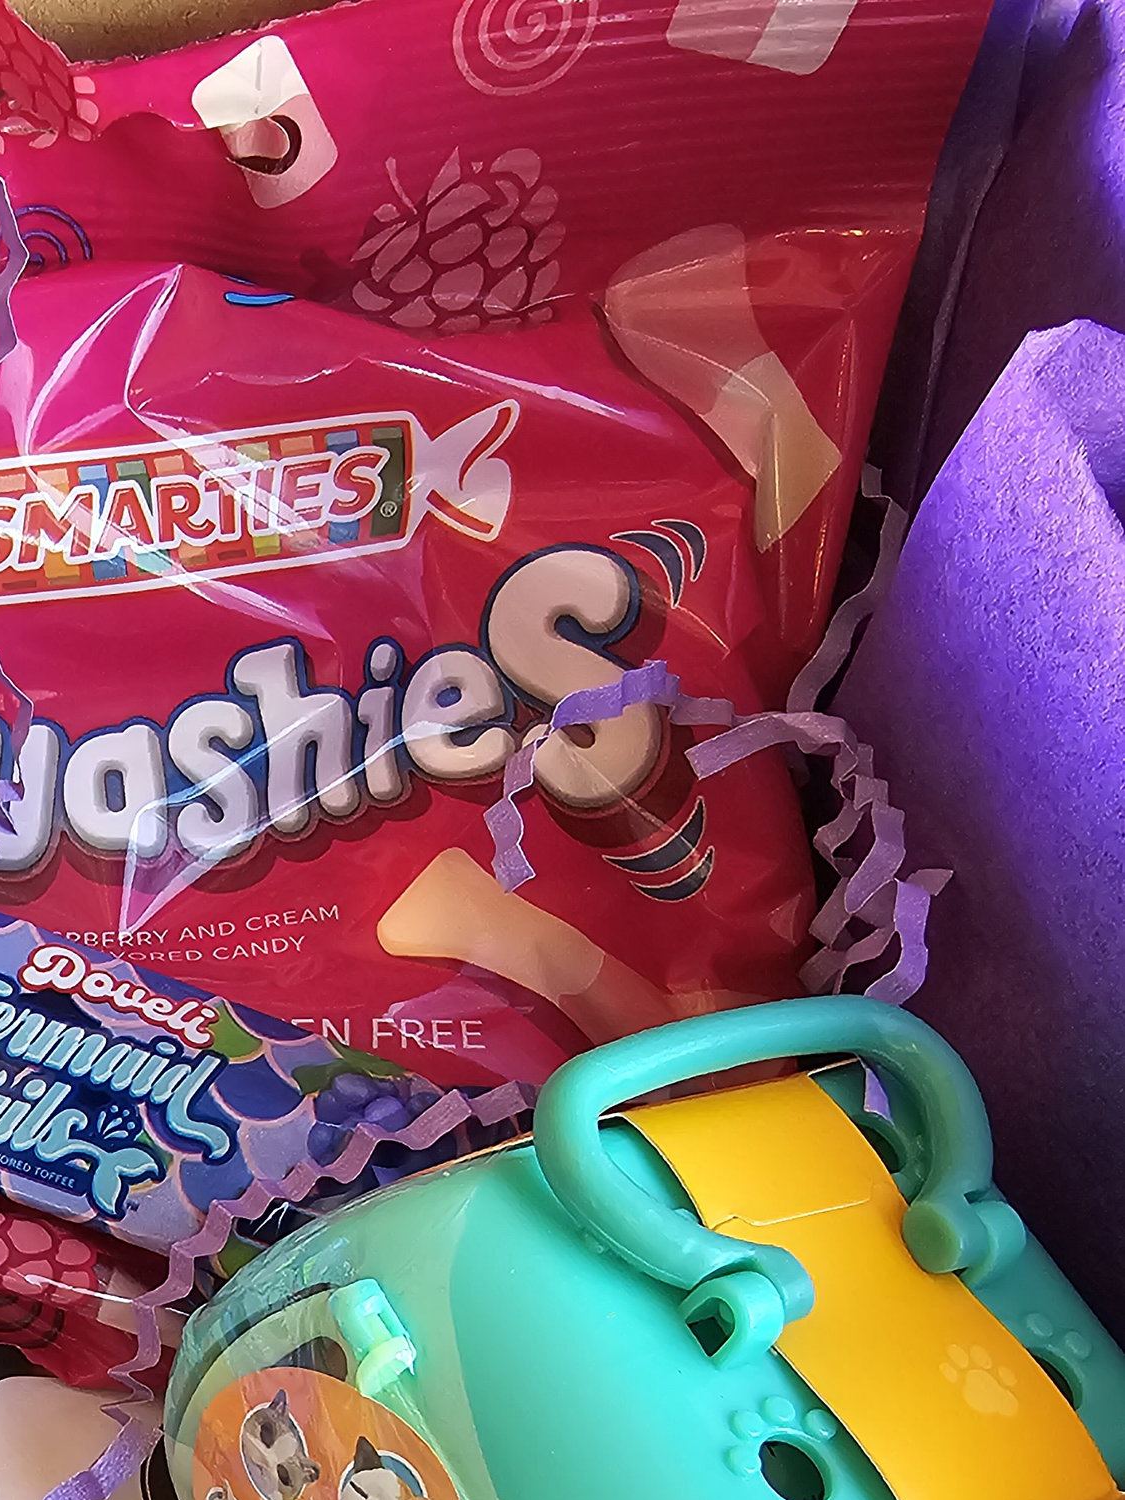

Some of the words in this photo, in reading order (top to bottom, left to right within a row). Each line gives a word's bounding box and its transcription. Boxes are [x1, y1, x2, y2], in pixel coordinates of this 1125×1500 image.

[179, 921, 235, 942] AND
[246, 904, 340, 932] CREAM
[212, 935, 306, 961] CANDY
[20, 945, 220, 1048] Doveli
[372, 1017, 488, 1050] FREE
[34, 1166, 75, 1189] TOFFEE
